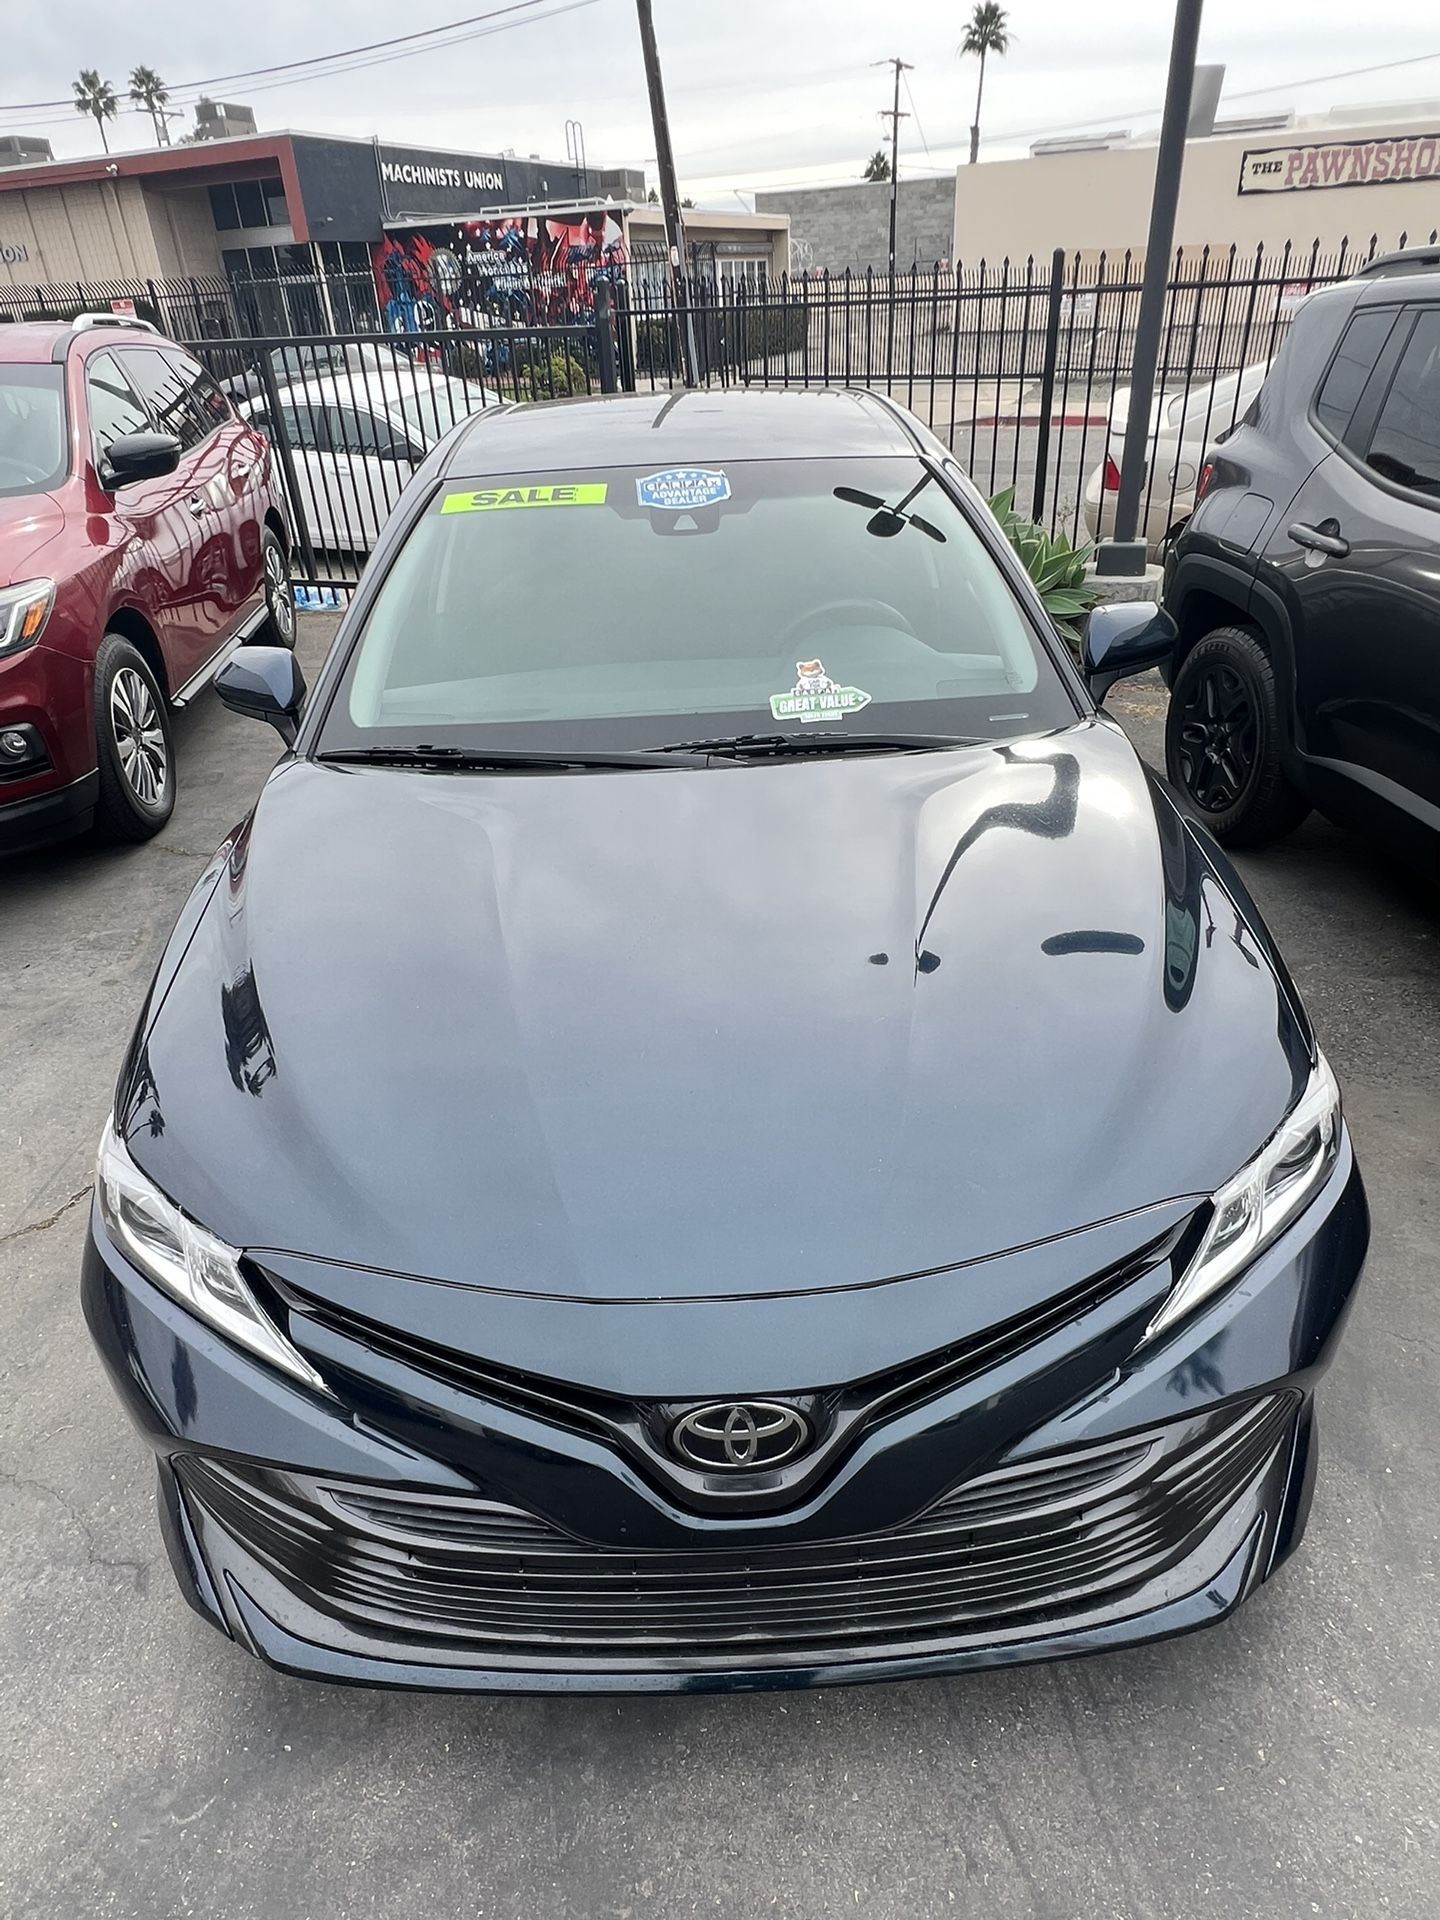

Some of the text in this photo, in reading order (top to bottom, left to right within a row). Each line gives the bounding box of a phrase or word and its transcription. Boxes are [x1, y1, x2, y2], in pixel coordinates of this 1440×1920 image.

[1252, 140, 1440, 186] THE PAWNSHO
[381, 162, 503, 190] MACHINISTS UNION
[471, 487, 576, 506] SALE
[652, 487, 717, 499] ADVANTAGE
[664, 495, 707, 505] DEALER
[779, 693, 856, 713] GREAT VALUE
